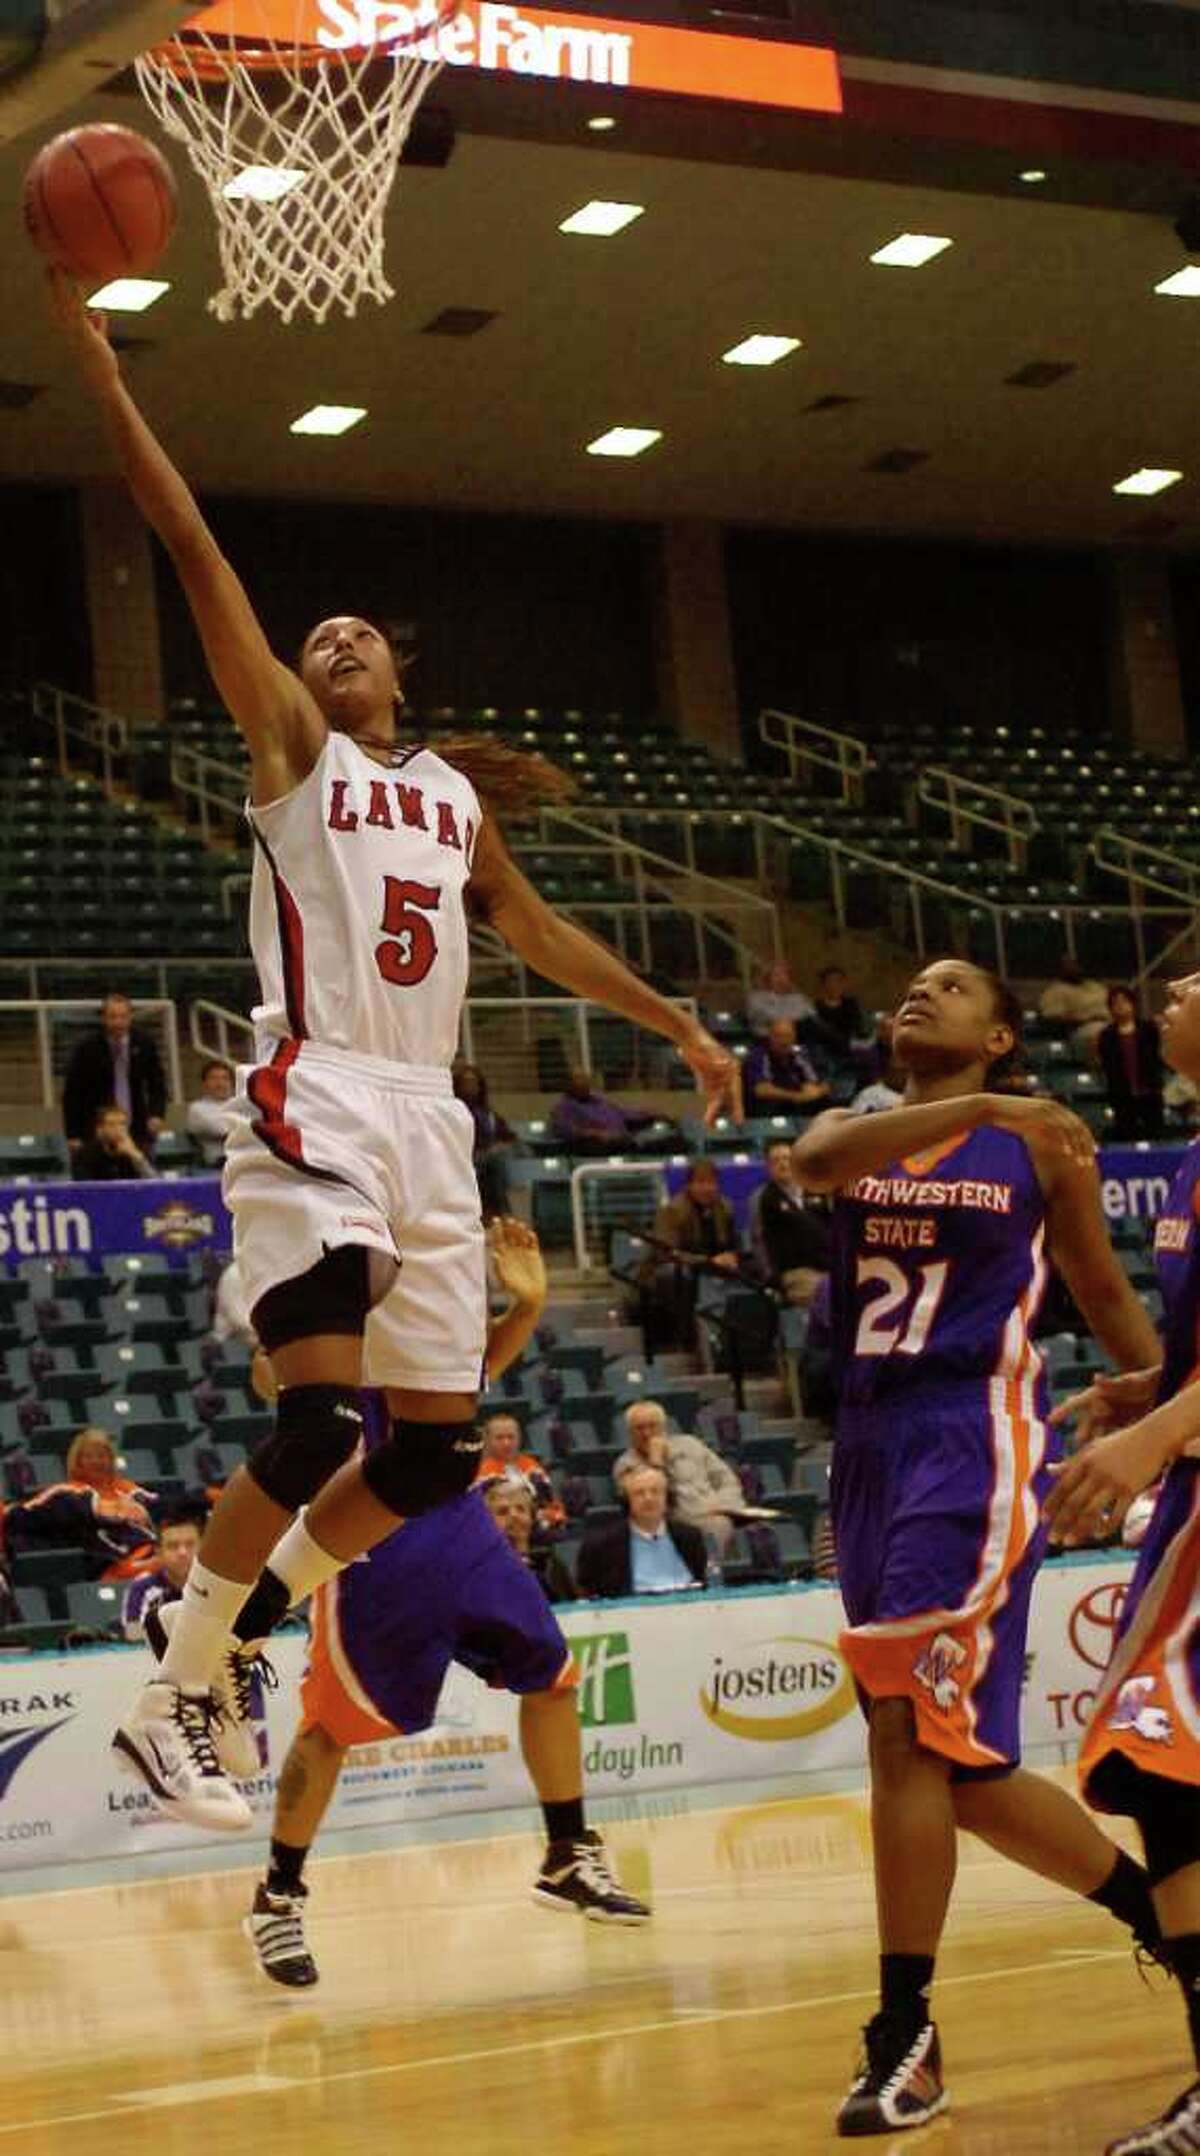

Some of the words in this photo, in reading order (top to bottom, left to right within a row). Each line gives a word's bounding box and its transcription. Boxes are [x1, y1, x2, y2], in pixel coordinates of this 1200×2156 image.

[328, 779, 475, 853] LAMA
[375, 875, 441, 987] 5
[864, 1216, 936, 1250] STATE
[854, 1256, 949, 1356] 21
[709, 1656, 838, 1715] jostens
[640, 1734, 684, 1769] Inn
[108, 1790, 162, 1812] Lea
